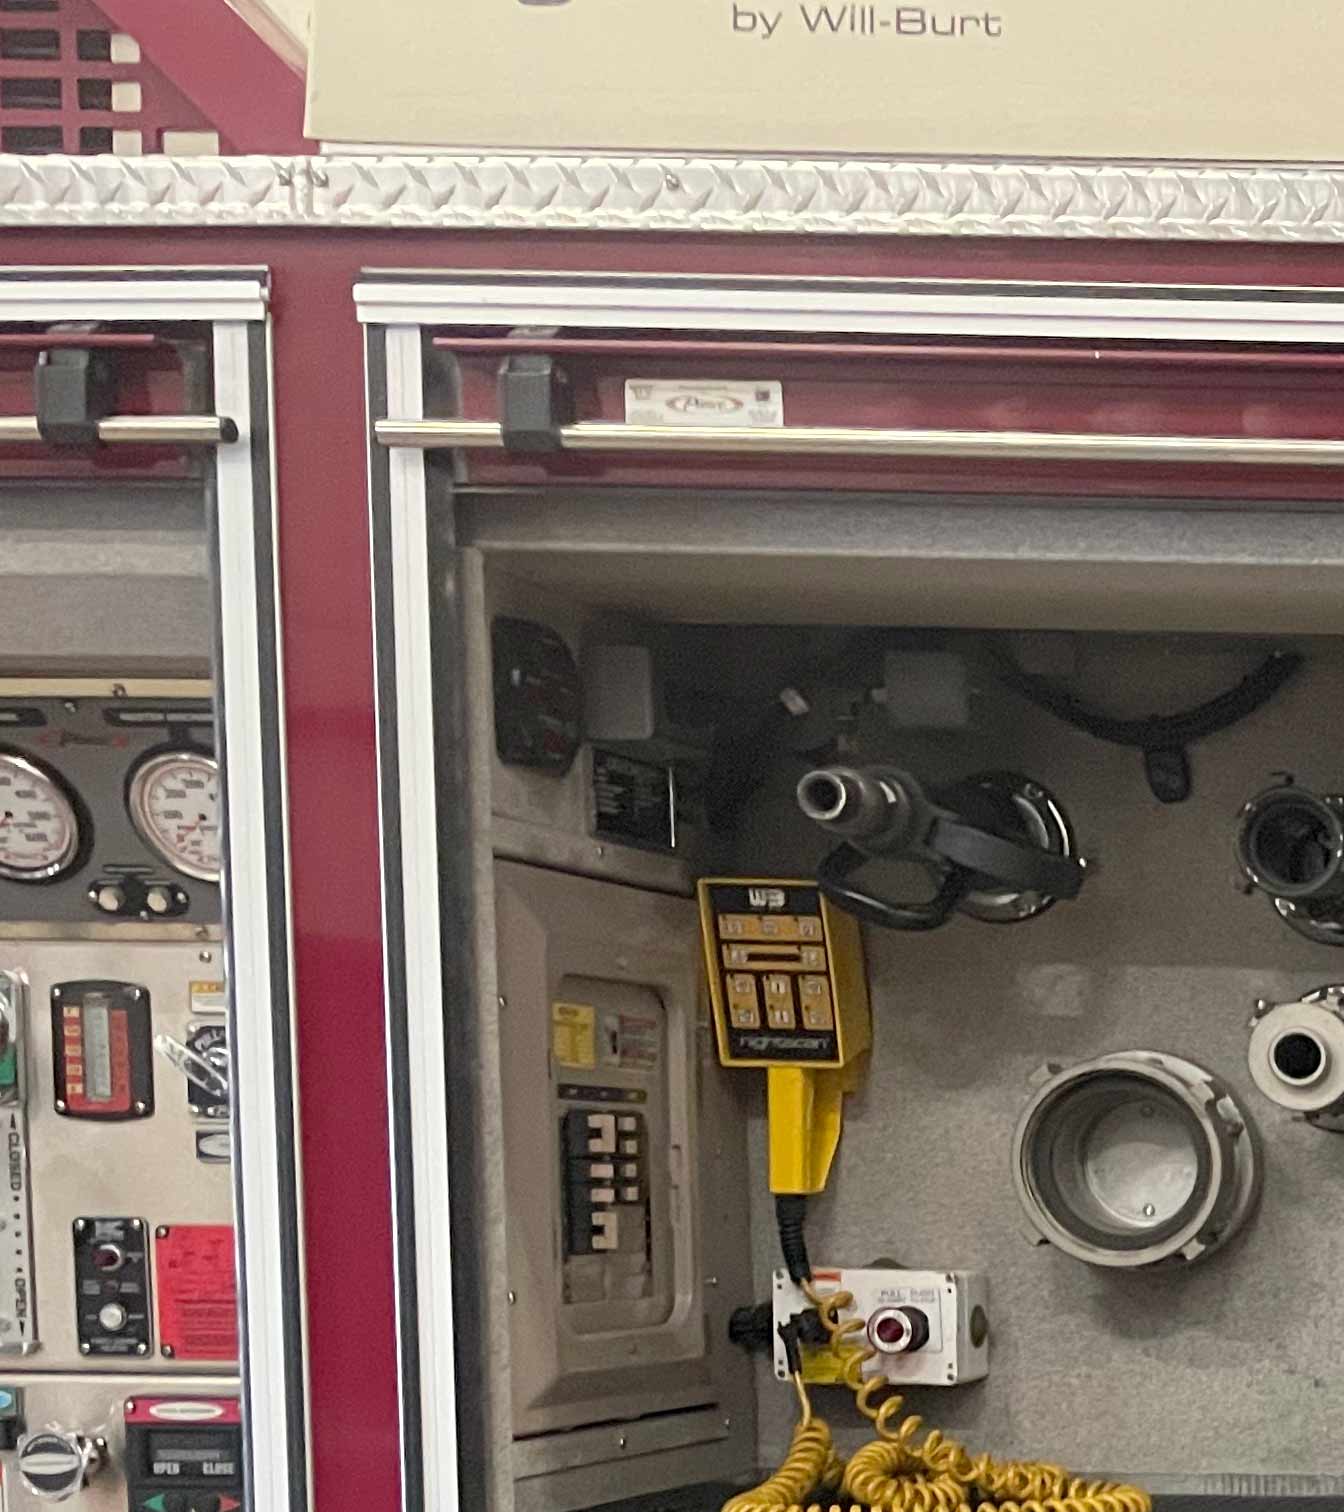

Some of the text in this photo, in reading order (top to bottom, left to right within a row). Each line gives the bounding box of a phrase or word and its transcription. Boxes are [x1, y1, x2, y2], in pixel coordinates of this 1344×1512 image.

[732, 3, 1002, 39] by Will-Burt
[9, 1132, 22, 1192] CLOSED
[15, 1277, 27, 1318] OPEN
